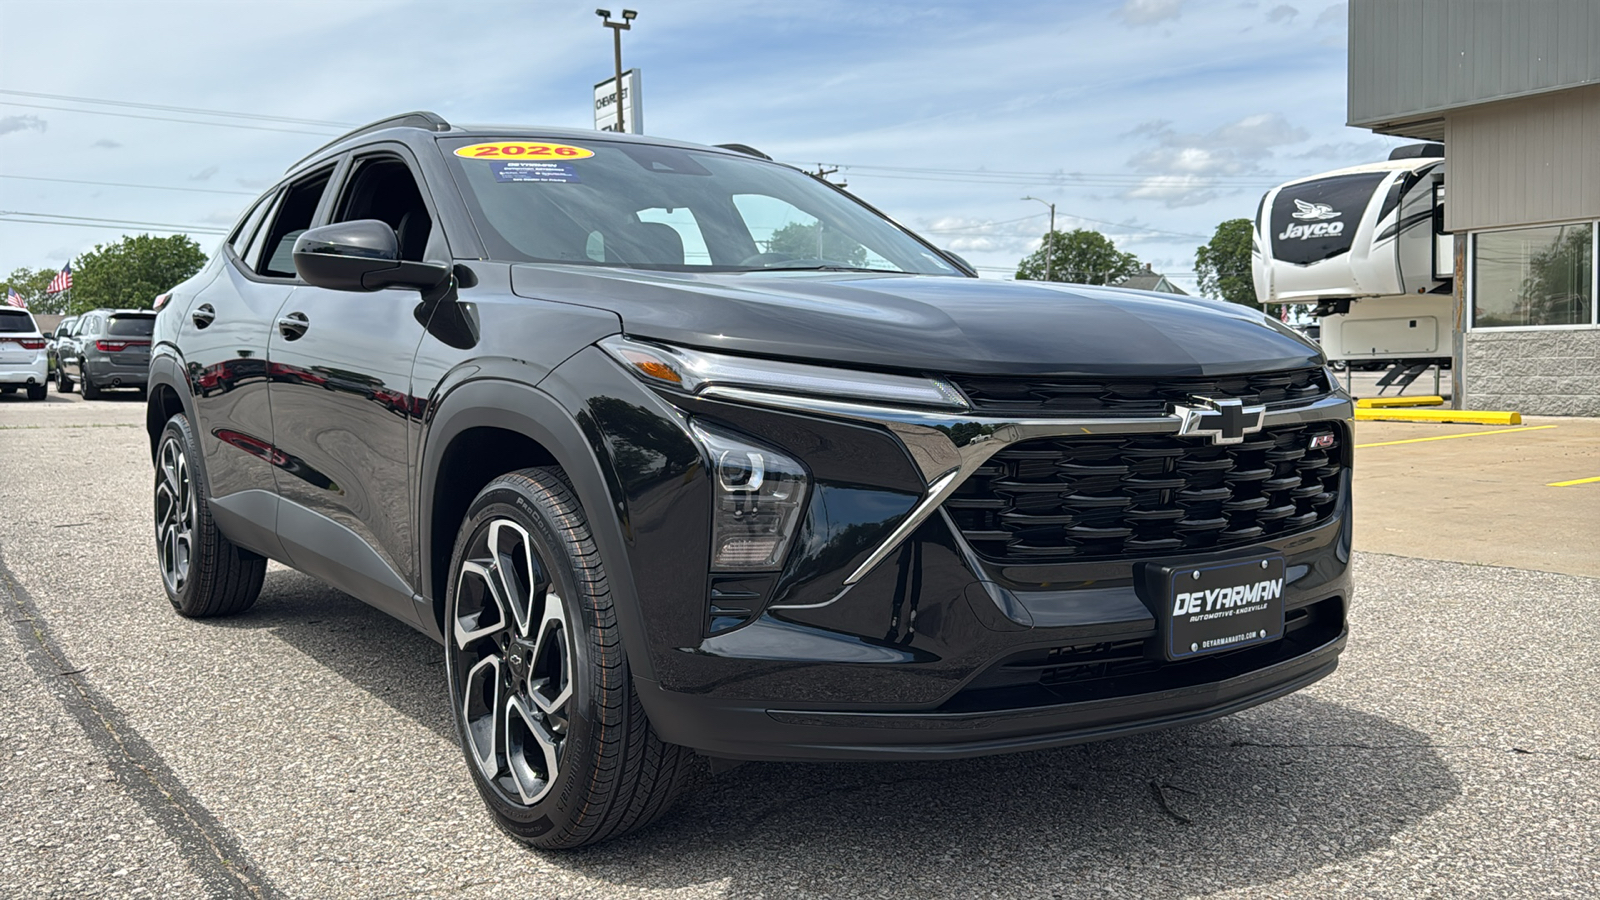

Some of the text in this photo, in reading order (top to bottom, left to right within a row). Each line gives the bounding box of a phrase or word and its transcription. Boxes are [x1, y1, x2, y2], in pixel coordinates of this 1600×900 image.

[596, 87, 628, 110] CHEVROET
[474, 146, 579, 157] 2026
[1278, 221, 1345, 241] Jayco
[1310, 434, 1334, 448] RS
[1172, 578, 1283, 617] DEYARMAN
[1189, 602, 1268, 623] AUTOMOTIVE-KNOXVILLE
[1202, 630, 1257, 648] DEYARMANAUTO.COM
